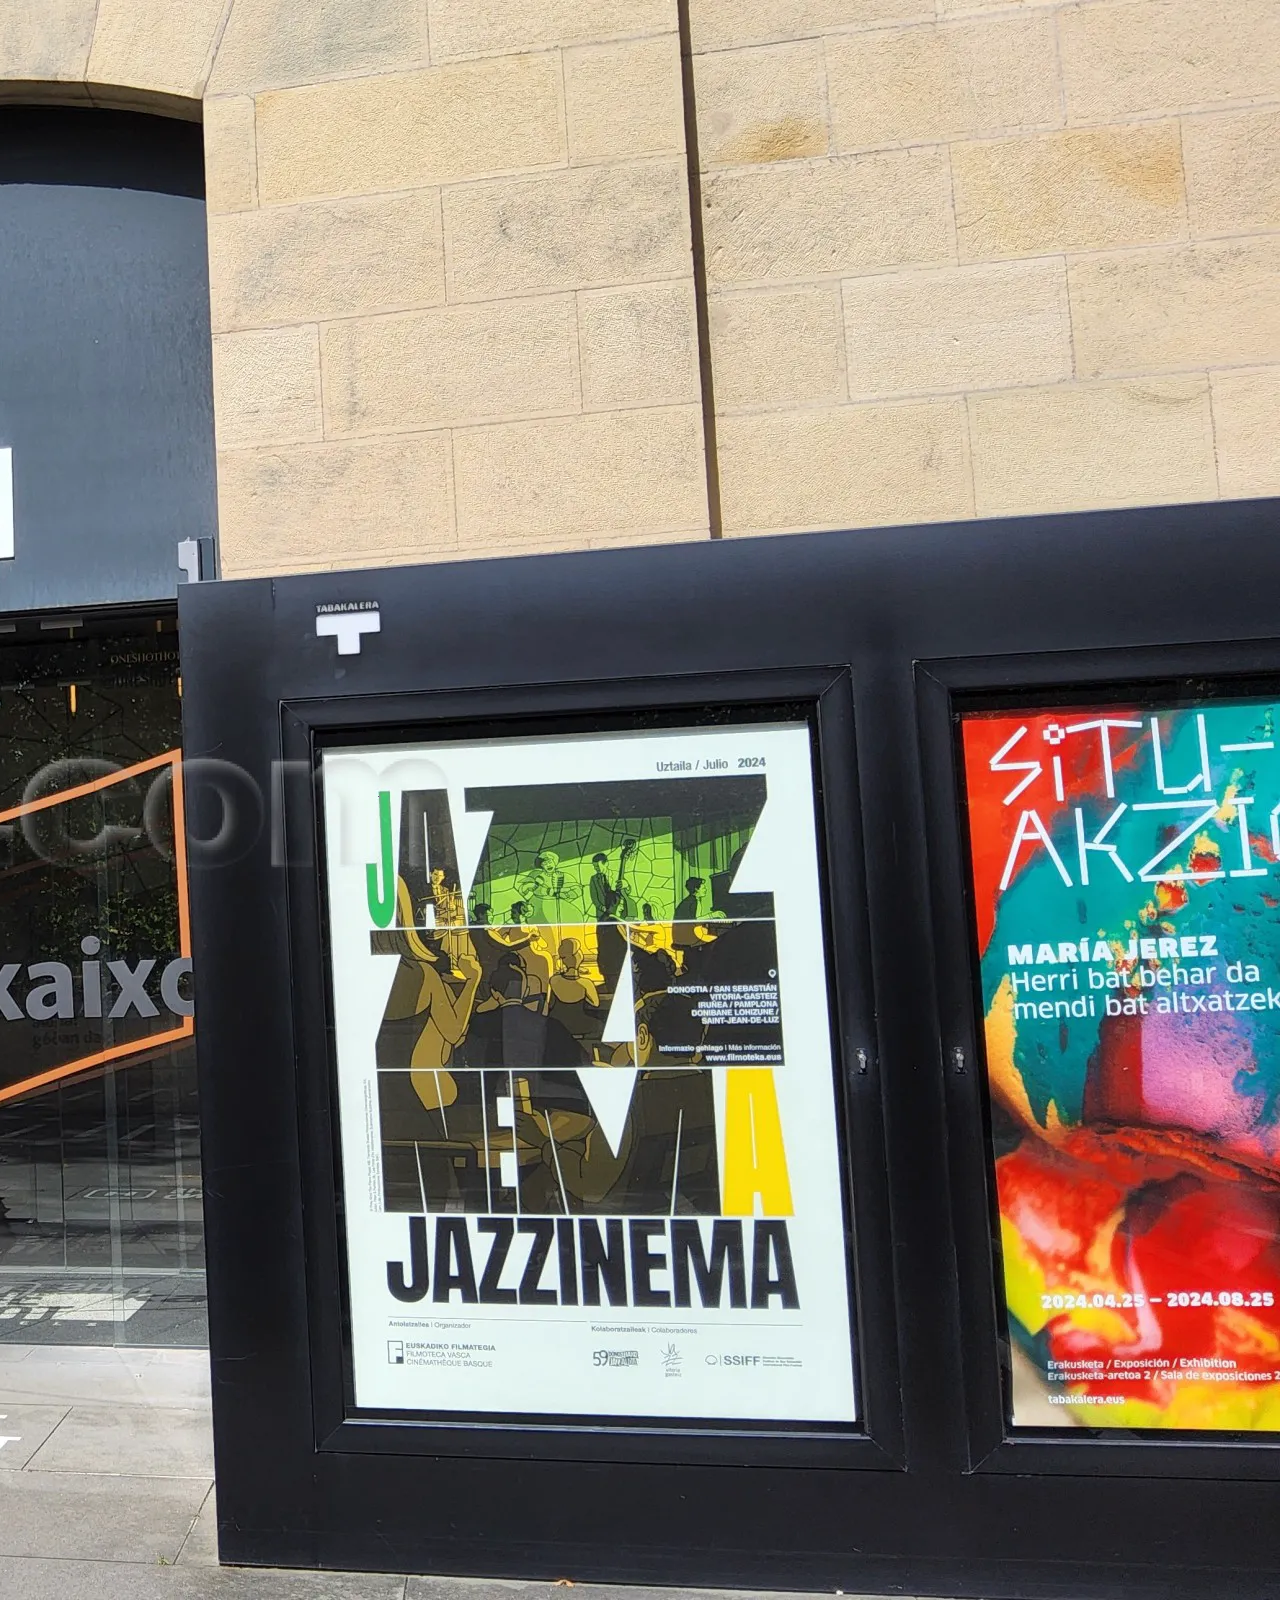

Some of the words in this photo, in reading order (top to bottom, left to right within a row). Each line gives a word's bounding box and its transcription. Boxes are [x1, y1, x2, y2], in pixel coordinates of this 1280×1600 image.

[316, 601, 379, 612] TABAKALERA
[656, 761, 692, 772] Uztaila
[695, 760, 700, 770] /
[703, 759, 728, 770] Julio
[737, 757, 766, 768] 2024
[999, 798, 1280, 891] AKZI
[1007, 937, 1114, 966] MARÍA
[1125, 935, 1219, 960] JEREZ
[1011, 967, 1078, 992] Herri
[1088, 966, 1133, 989] bat
[1139, 962, 1217, 987] behar
[1226, 961, 1260, 983] da
[667, 985, 708, 994] DONOSTIA
[714, 985, 731, 993] SAN
[732, 983, 777, 992] SEBASTIÁN
[709, 992, 778, 1000] VITORIA-GASTEIZ
[698, 1000, 729, 1008] IRUÑEA
[734, 1000, 778, 1008] PAMPLONA
[1014, 994, 1095, 1020] mendi
[1105, 993, 1148, 1016] bat
[691, 1009, 732, 1017] DONIBANE
[734, 1008, 774, 1016] LOHIZUNE
[701, 1016, 780, 1025] SAINT-JEAN-DE-LUZ
[706, 1054, 782, 1062] www.filmoteka.eus
[386, 1215, 801, 1310] JAZZINEMA
[1041, 1293, 1145, 1309] 2024.04.25
[1167, 1292, 1275, 1307] 2024.08.25
[434, 1321, 471, 1329] Organizador
[406, 1350, 446, 1358] FILMOTECA
[593, 1349, 608, 1366] 59
[723, 1355, 761, 1366] SSIFF
[1047, 1360, 1104, 1369] Erakusketa
[1114, 1358, 1170, 1369] Exposición
[1180, 1357, 1237, 1369] Exhibition
[1047, 1371, 1141, 1380] Erakusketa-aretoa
[1144, 1370, 1151, 1379] 2
[1161, 1370, 1183, 1380] Sala
[1185, 1370, 1200, 1379] de
[1202, 1371, 1272, 1382] exposiciones
[1047, 1394, 1125, 1404] tabakalera.eus
